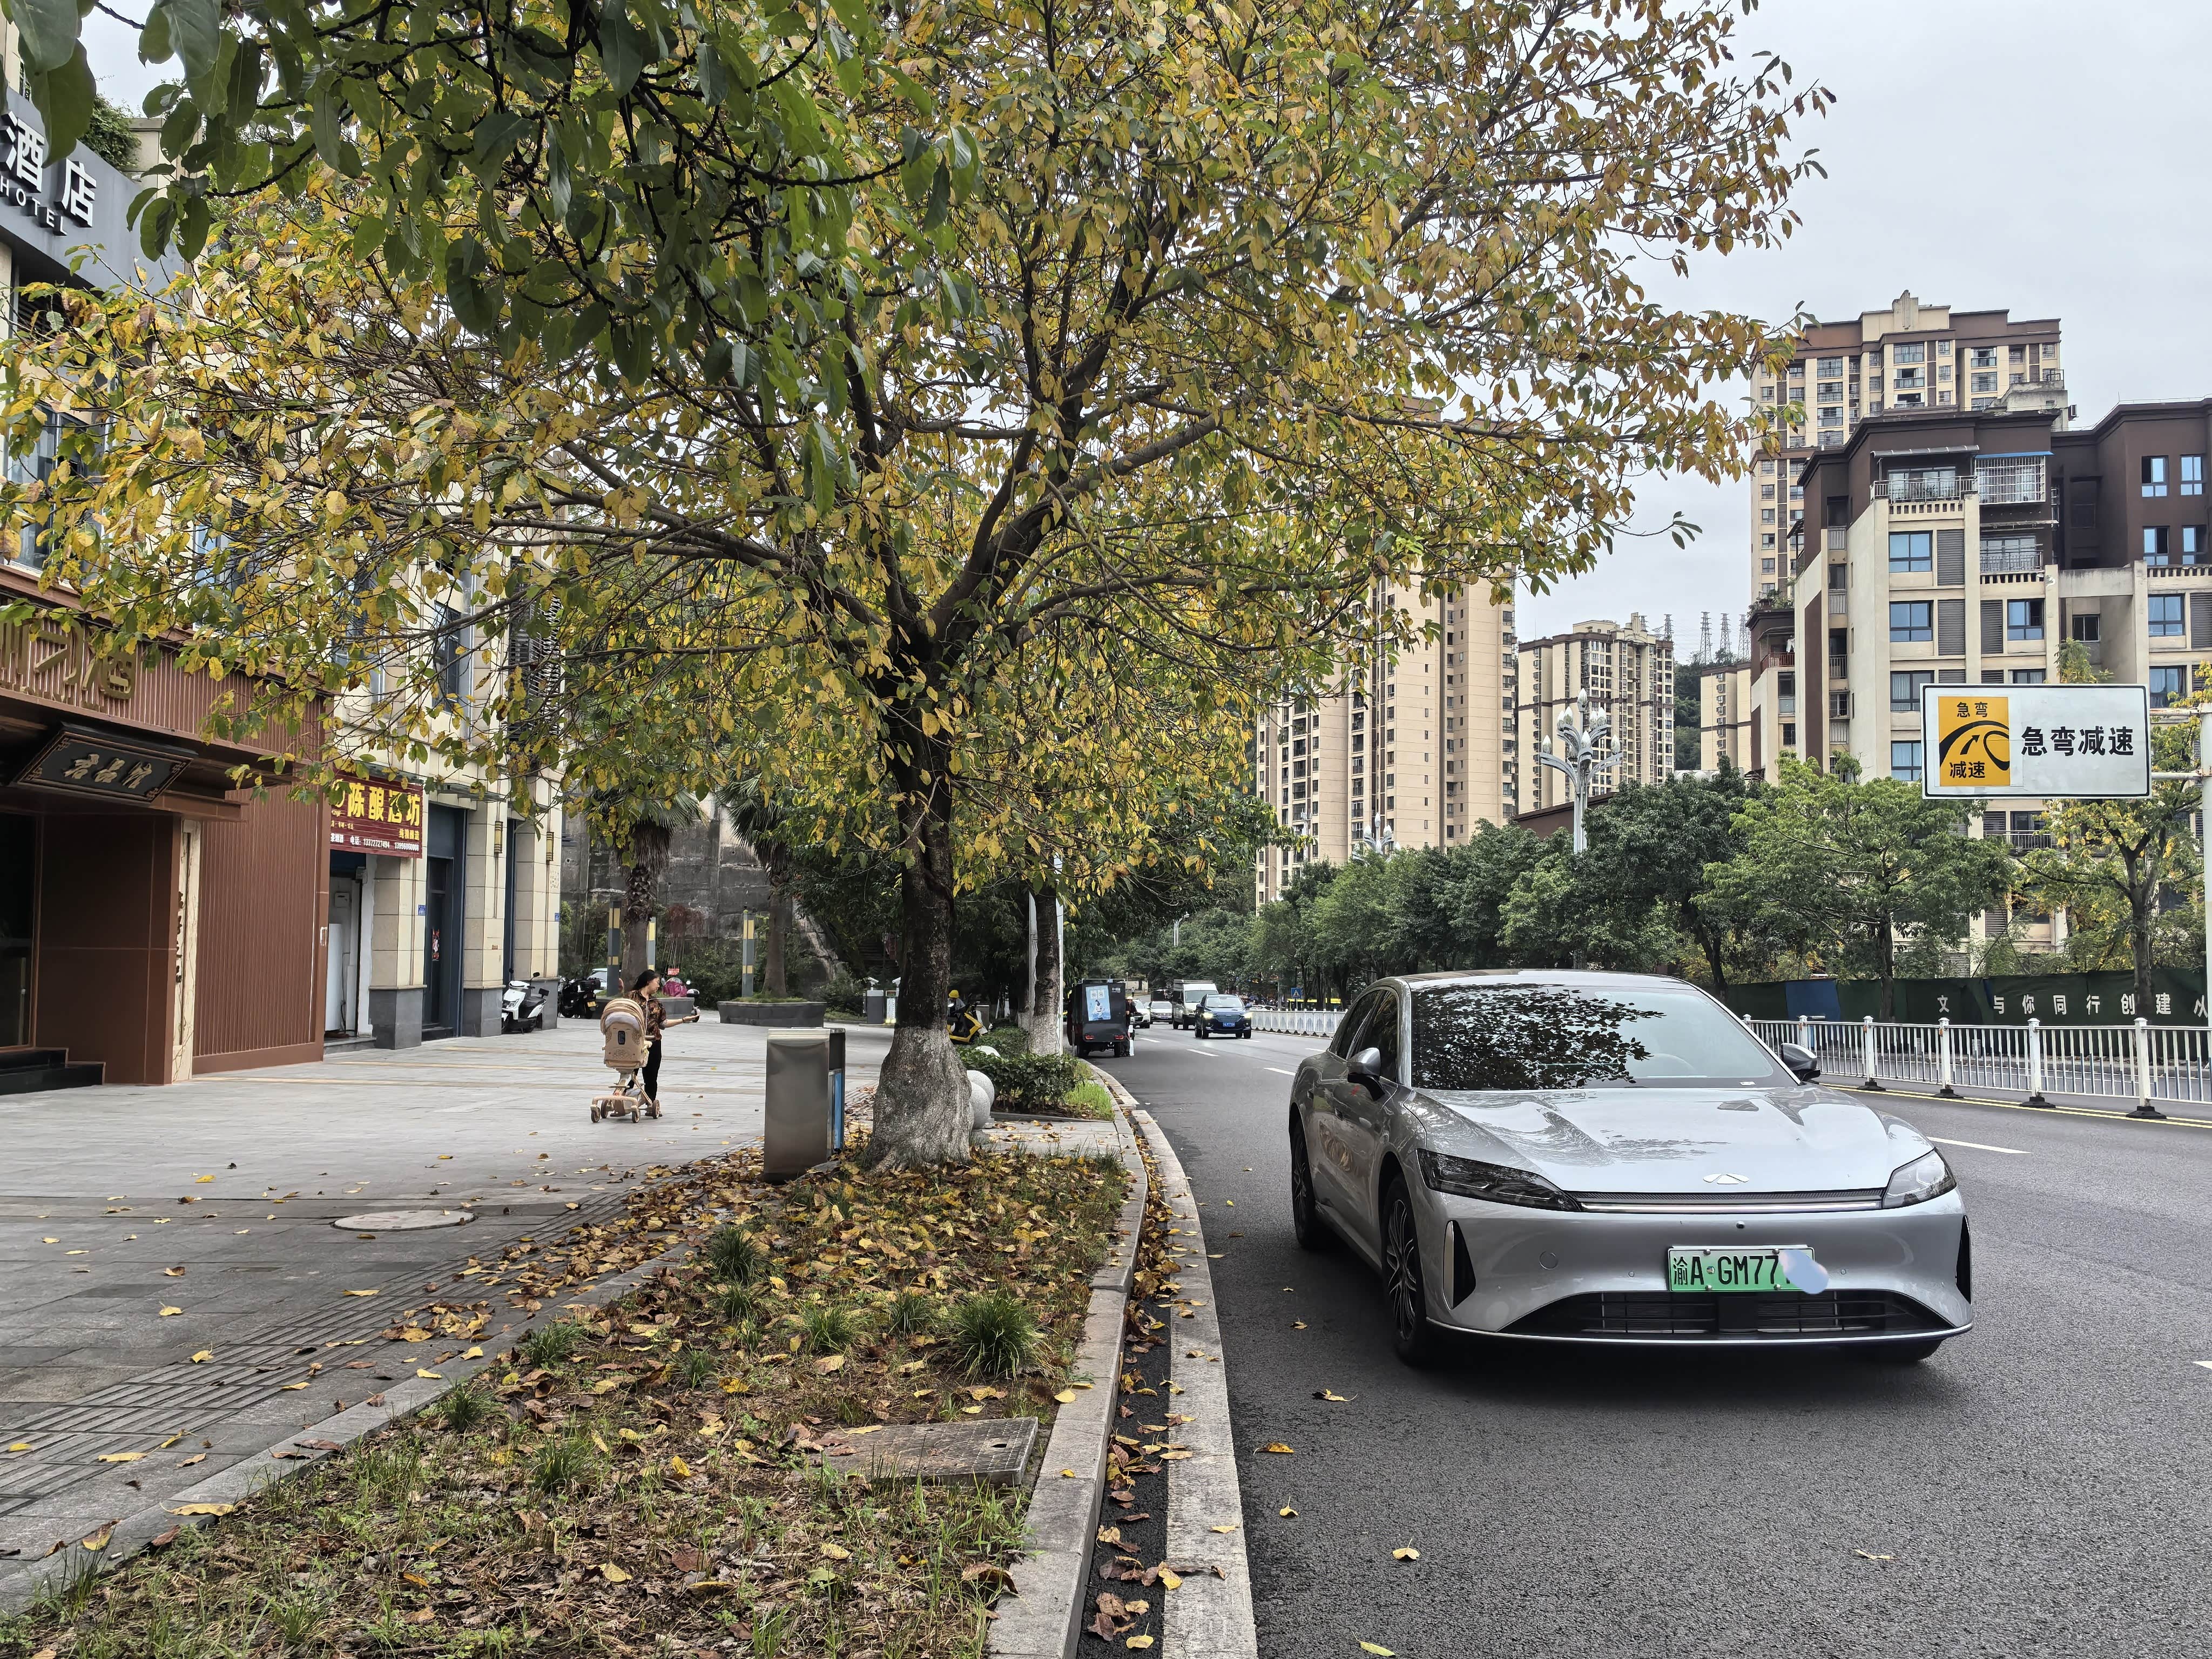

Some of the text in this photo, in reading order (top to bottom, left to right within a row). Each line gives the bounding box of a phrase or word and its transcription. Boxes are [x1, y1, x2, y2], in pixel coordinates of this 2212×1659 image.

[6, 111, 97, 227] 酒店
[1, 176, 68, 236] HOTEL
[1956, 702, 1988, 718] 急弯
[2021, 726, 2134, 757] 急弯减速
[1949, 761, 1986, 779] 减速
[331, 779, 420, 826] 陈酿酒坊
